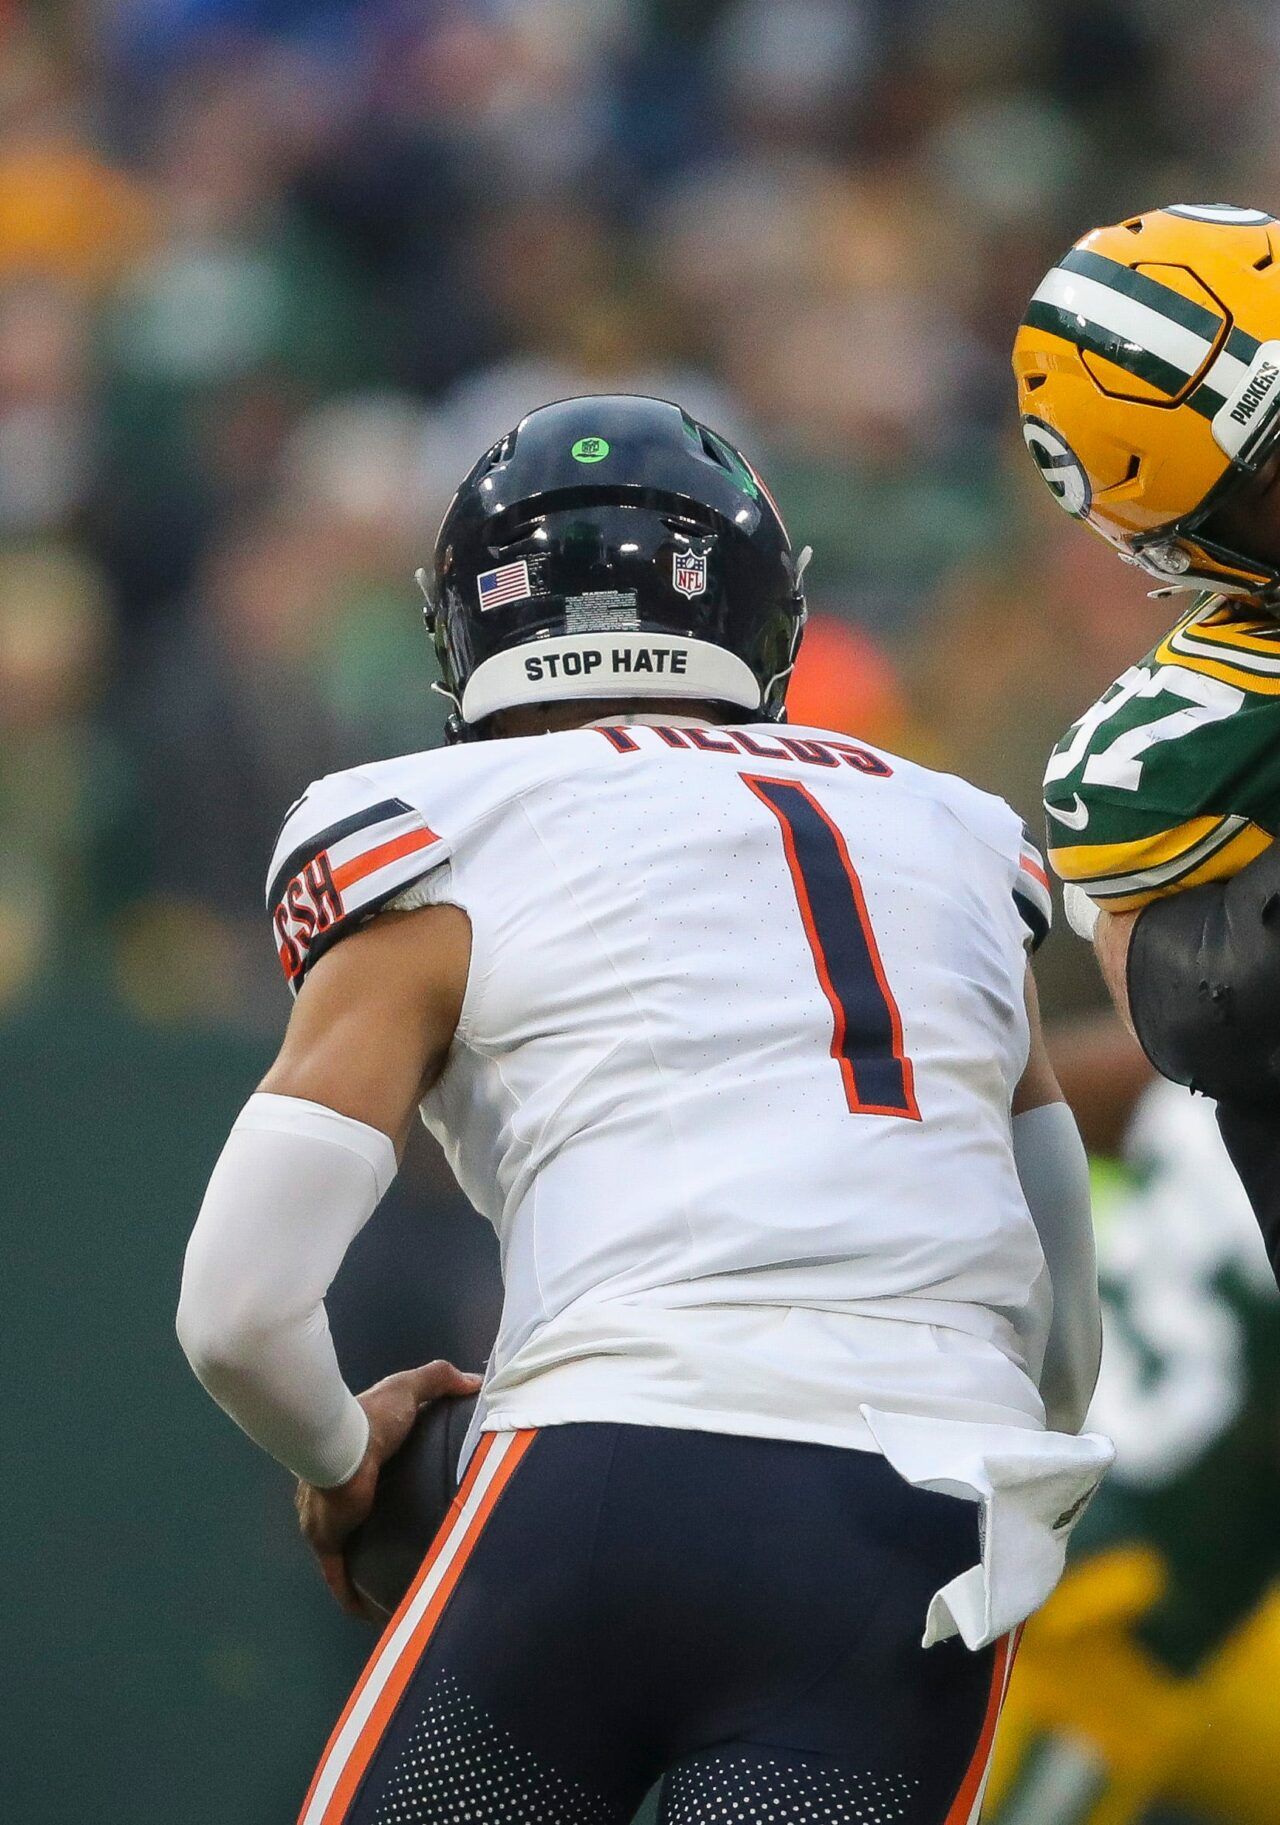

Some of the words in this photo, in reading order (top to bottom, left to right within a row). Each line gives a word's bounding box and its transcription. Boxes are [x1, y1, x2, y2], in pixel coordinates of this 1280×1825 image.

[1229, 361, 1280, 426] PACKERS
[677, 569, 702, 591] NFL
[524, 650, 603, 682] STOP
[612, 649, 688, 675] HATE
[274, 849, 346, 977] GSH
[737, 771, 923, 1122] 1
